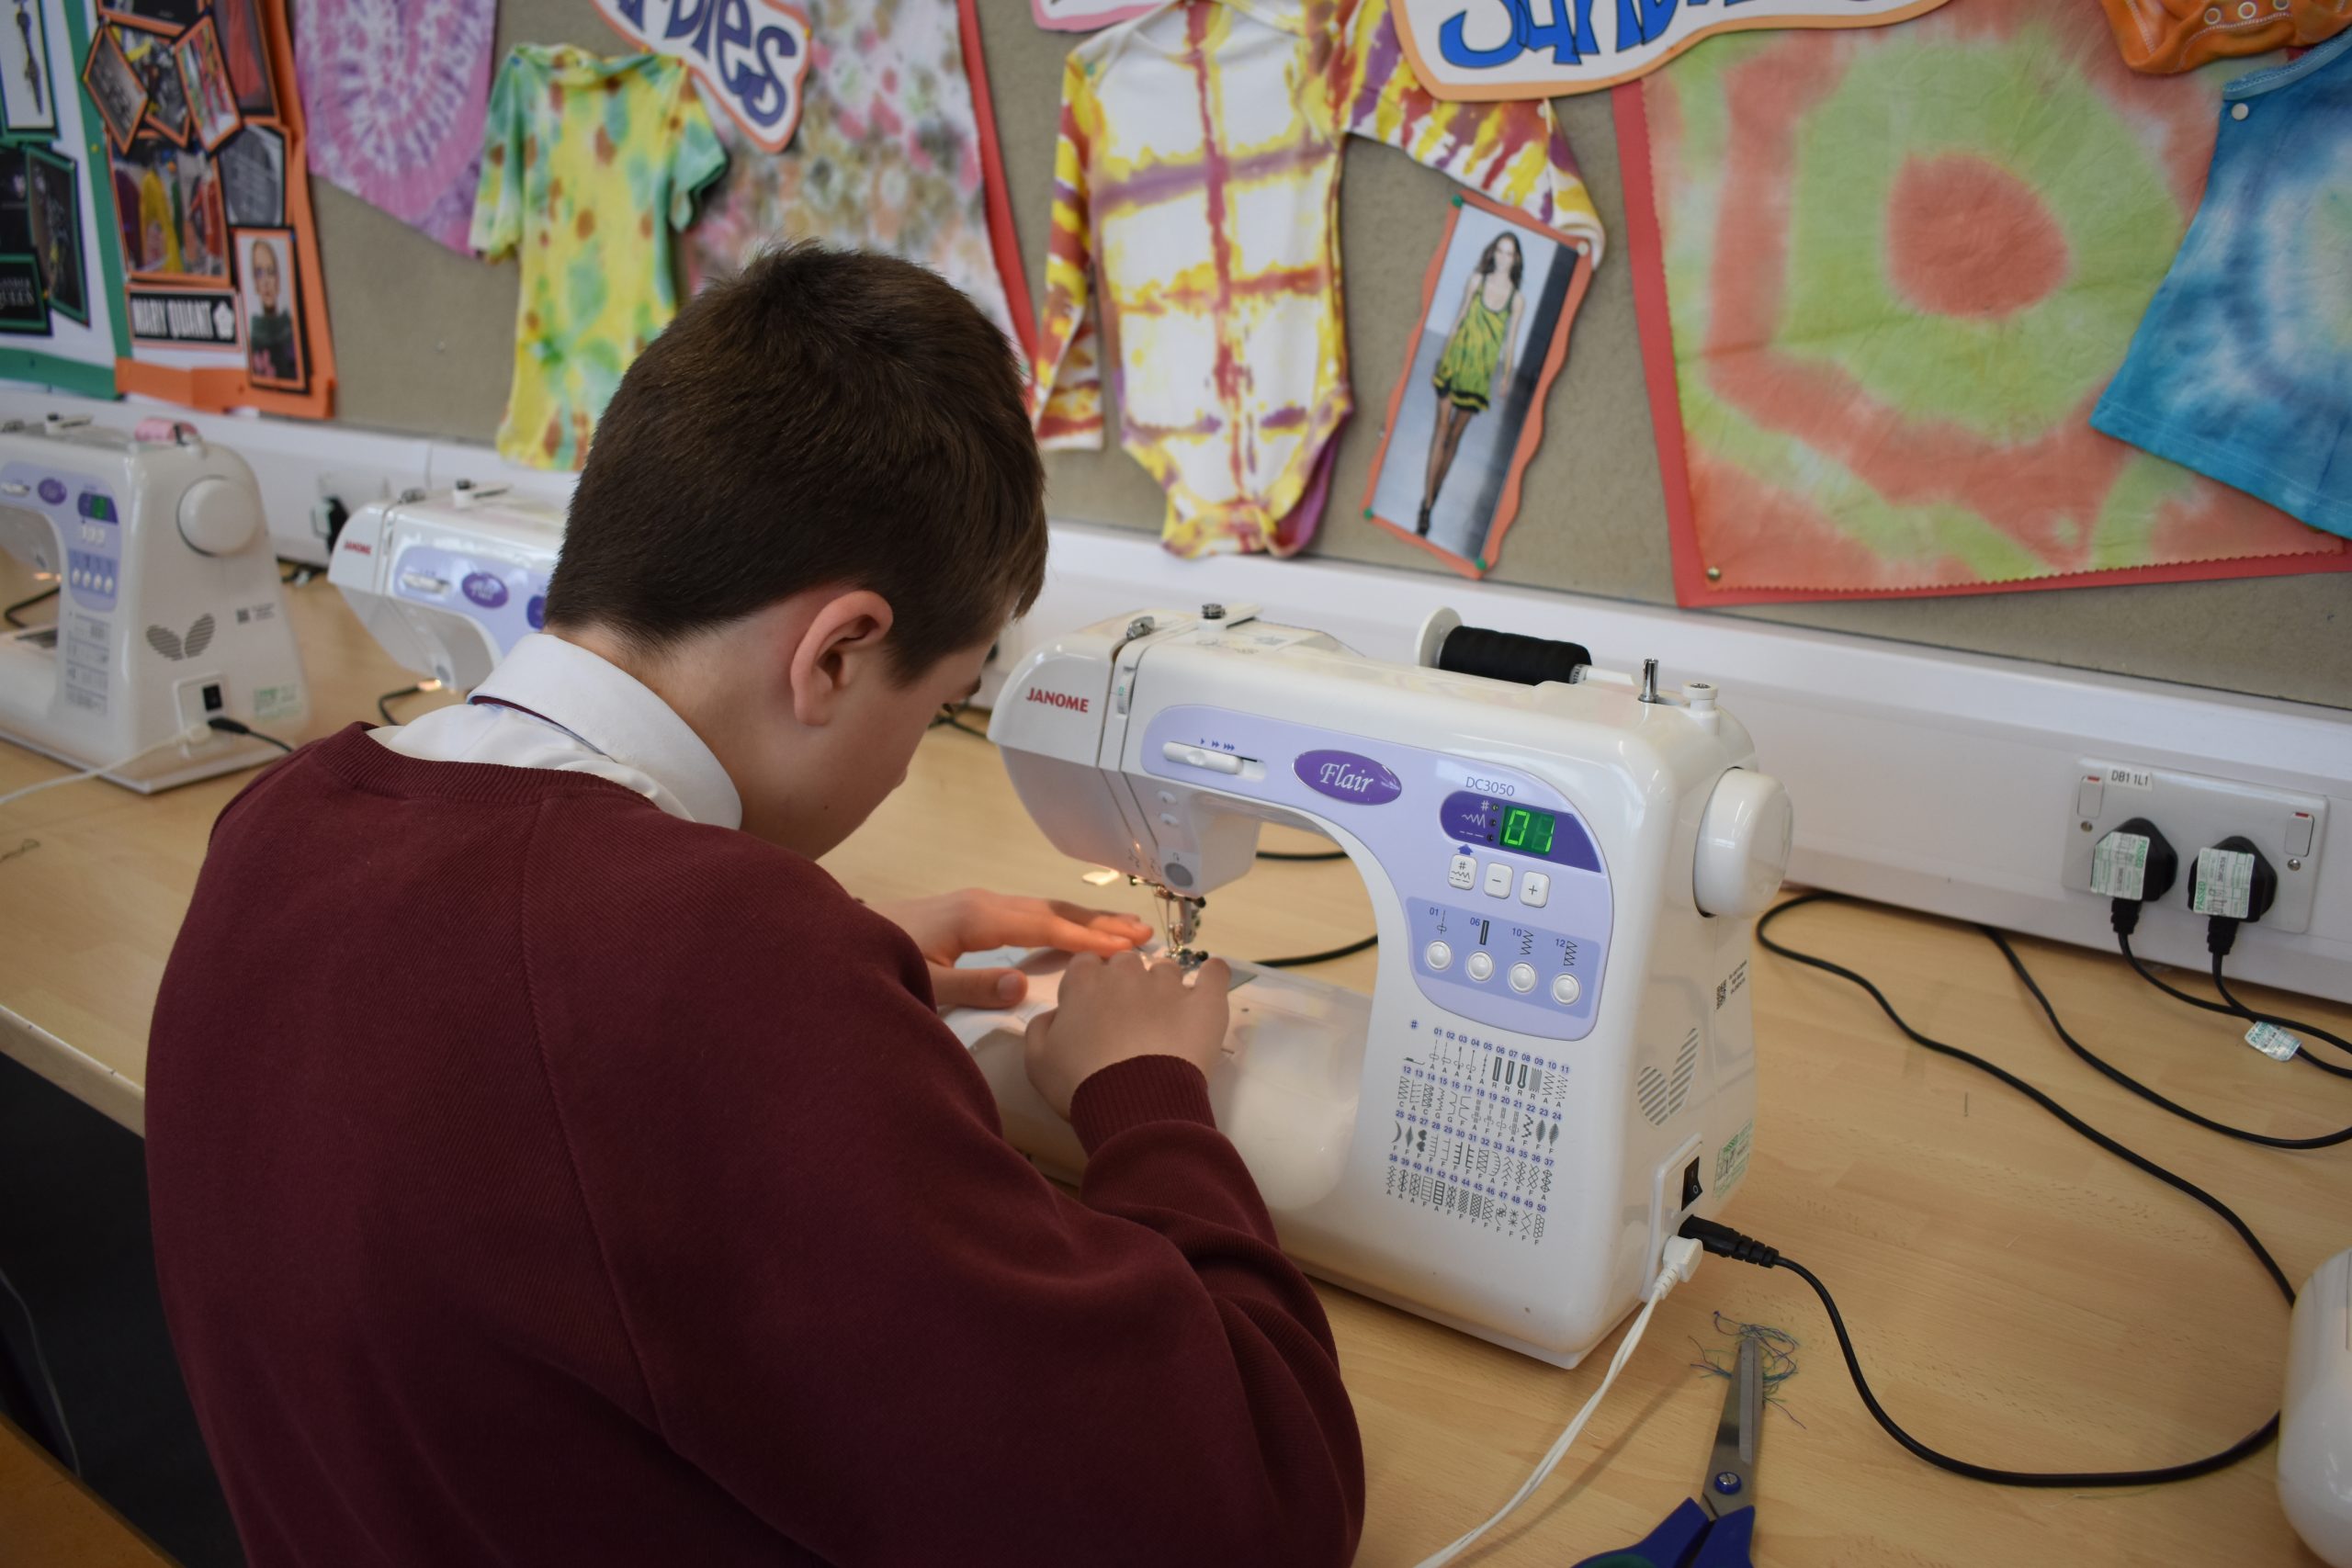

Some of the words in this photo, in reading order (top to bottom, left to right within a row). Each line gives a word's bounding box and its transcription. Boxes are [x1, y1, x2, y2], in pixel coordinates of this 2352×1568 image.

[1026, 687, 1089, 713] JANOME
[1320, 762, 1374, 793] Flair
[1465, 776, 1514, 796] DC3050
[1504, 809, 1555, 852] 01
[1430, 907, 1439, 916] 01
[1470, 917, 1480, 926] 06
[1512, 928, 1522, 937] 10
[1555, 939, 1566, 947] 12
